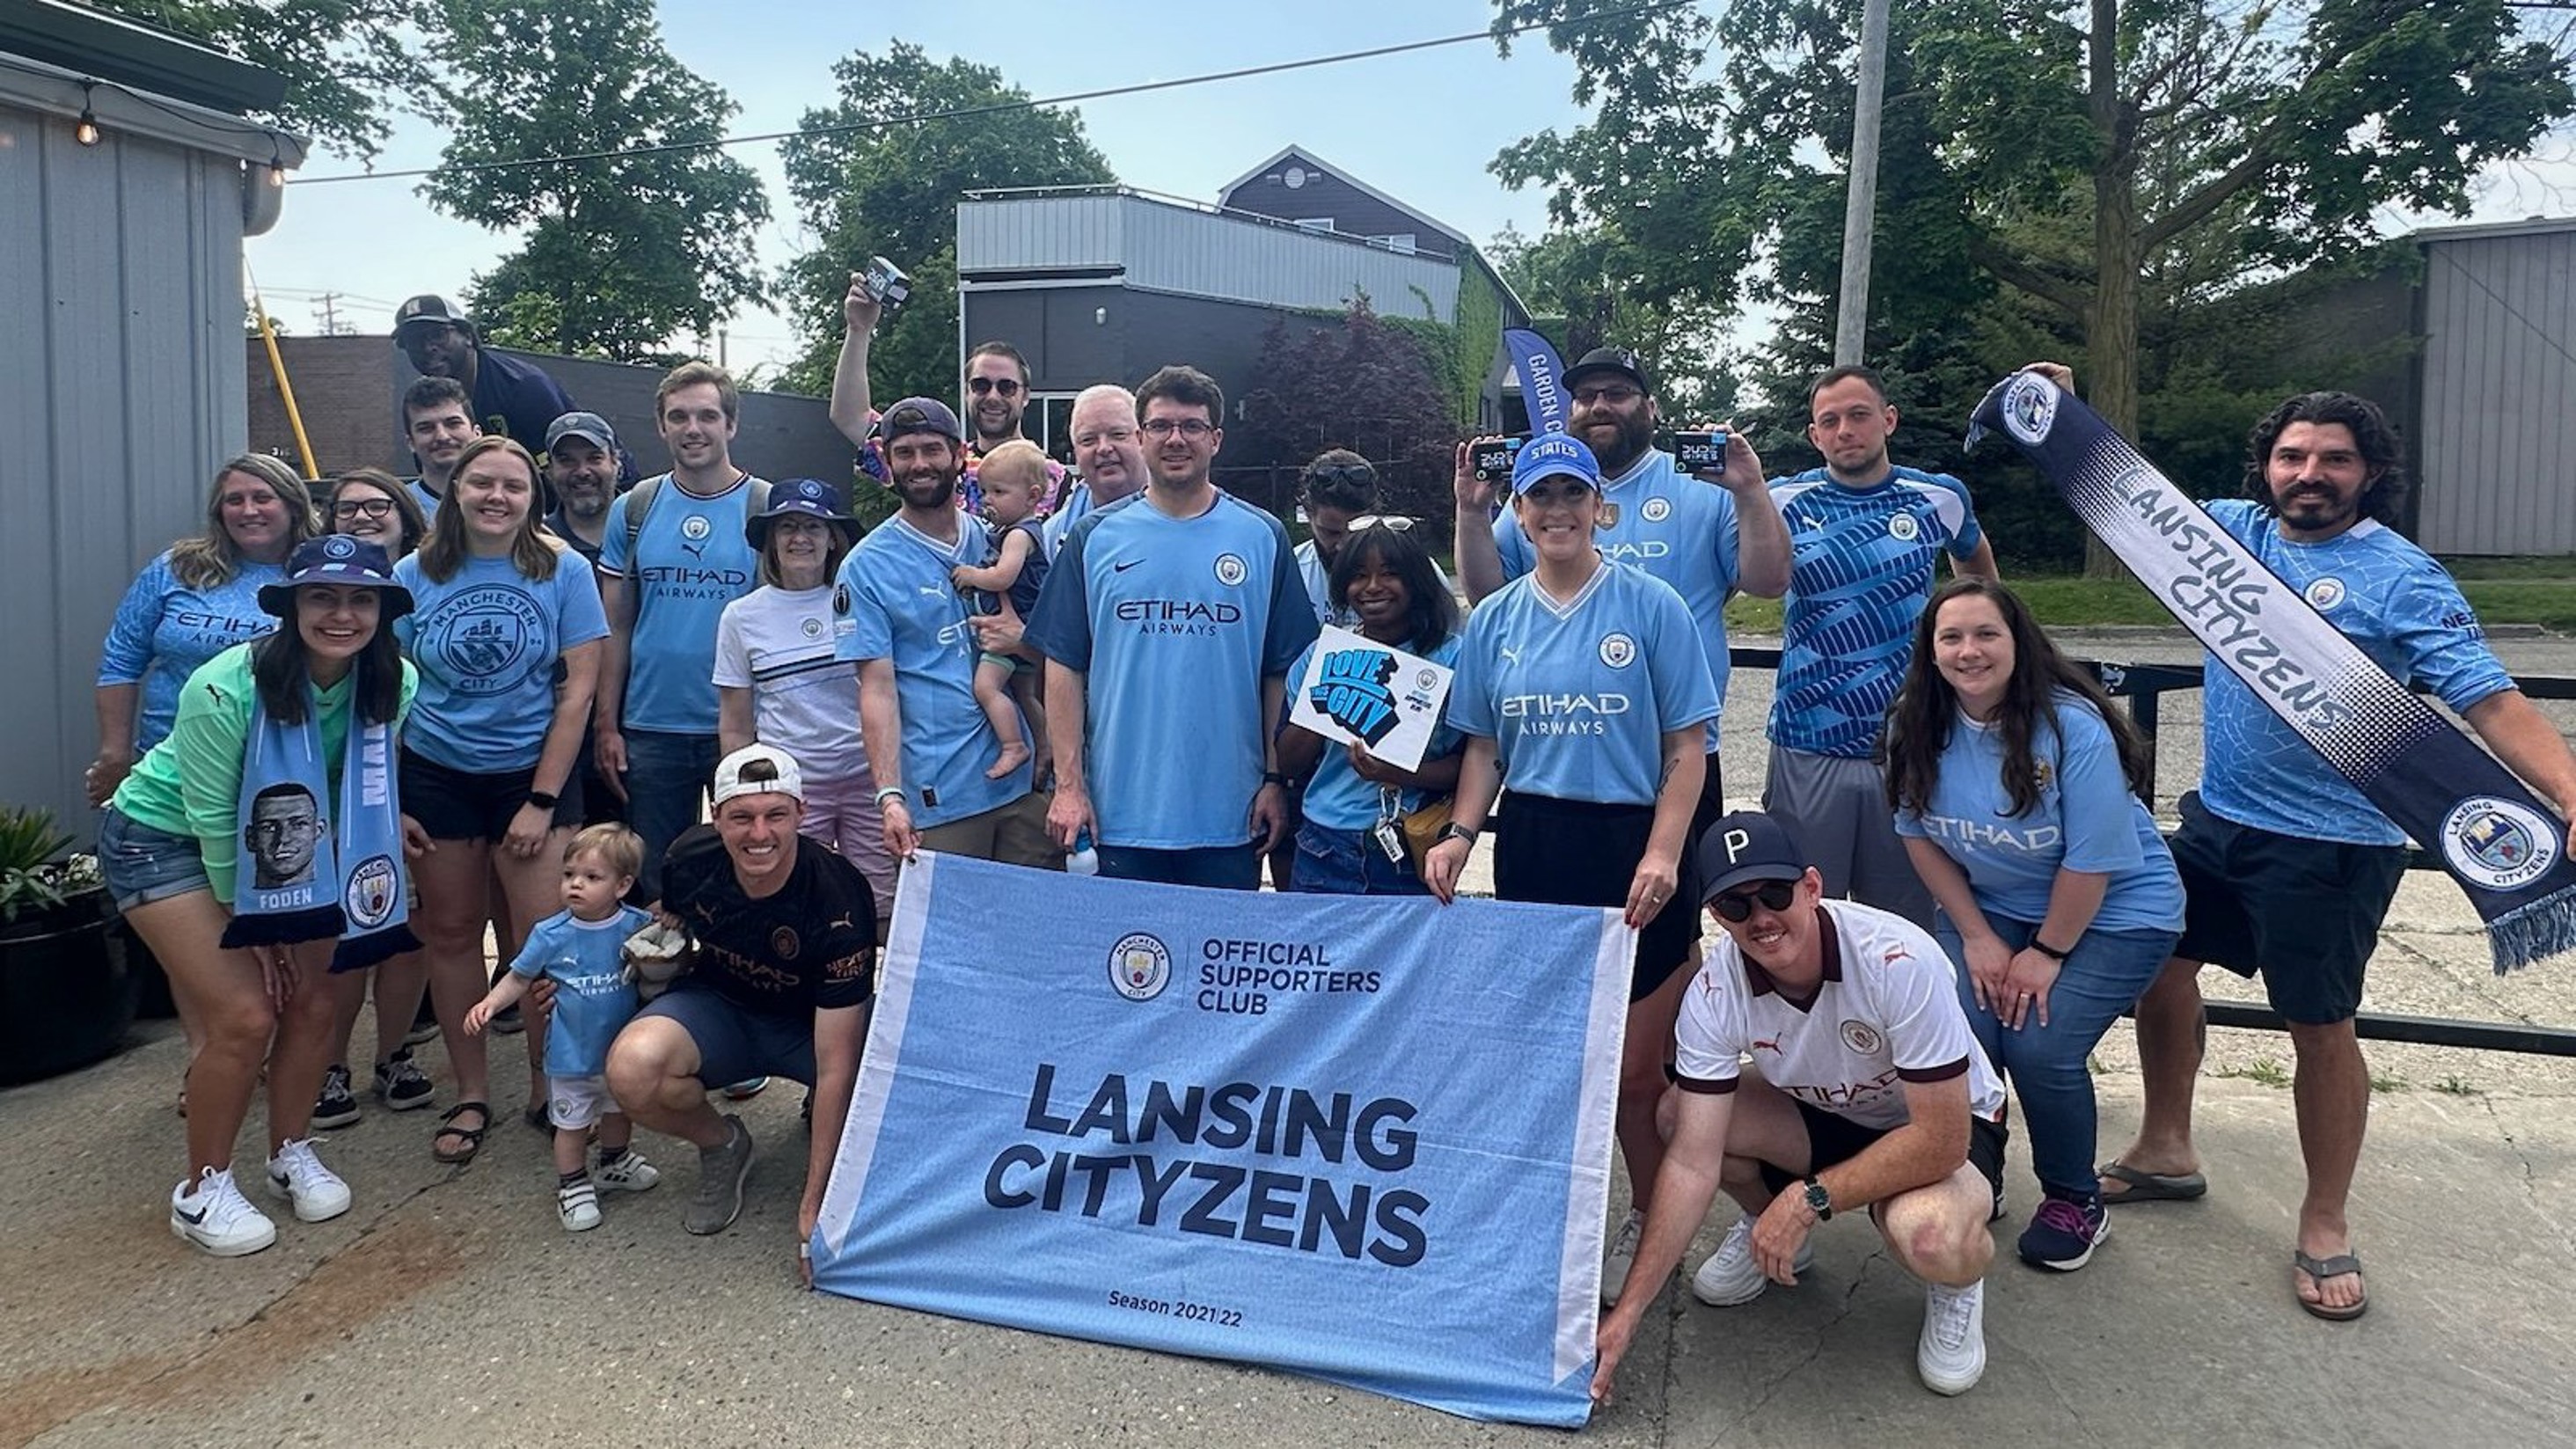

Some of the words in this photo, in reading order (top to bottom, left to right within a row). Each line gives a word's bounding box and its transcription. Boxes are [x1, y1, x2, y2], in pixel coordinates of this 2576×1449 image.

[1528, 354, 1560, 418] GARDEN
[1531, 441, 1577, 459] STATES
[1597, 540, 1669, 559] HAD
[2112, 468, 2268, 615] LANSING
[642, 567, 746, 585] ETIHAD
[655, 587, 726, 599] AIRWAYS
[434, 592, 538, 628] MANCHESTER
[1116, 599, 1241, 624] ETIHAD
[1139, 623, 1217, 637] AIRWAYS
[2170, 575, 2353, 729] CITYZENS
[1321, 649, 1391, 684] LOVE
[459, 678, 498, 690] CITY
[1327, 685, 1393, 735] CITY
[1501, 693, 1630, 717] ETIHAD
[1519, 721, 1604, 735] AIRWAYS
[2448, 801, 2493, 836] LANSING
[1723, 829, 1749, 864] P
[2493, 847, 2550, 884] CITYZENS
[260, 887, 312, 909] FODEN
[1203, 939, 1330, 966] OFFICIAL
[1199, 964, 1380, 993] SUPPORTERS
[1197, 990, 1268, 1014] CLUB
[1024, 1063, 1418, 1172] LANSING
[984, 1144, 1431, 1267] CITYZENS
[1109, 1291, 1170, 1314] Season
